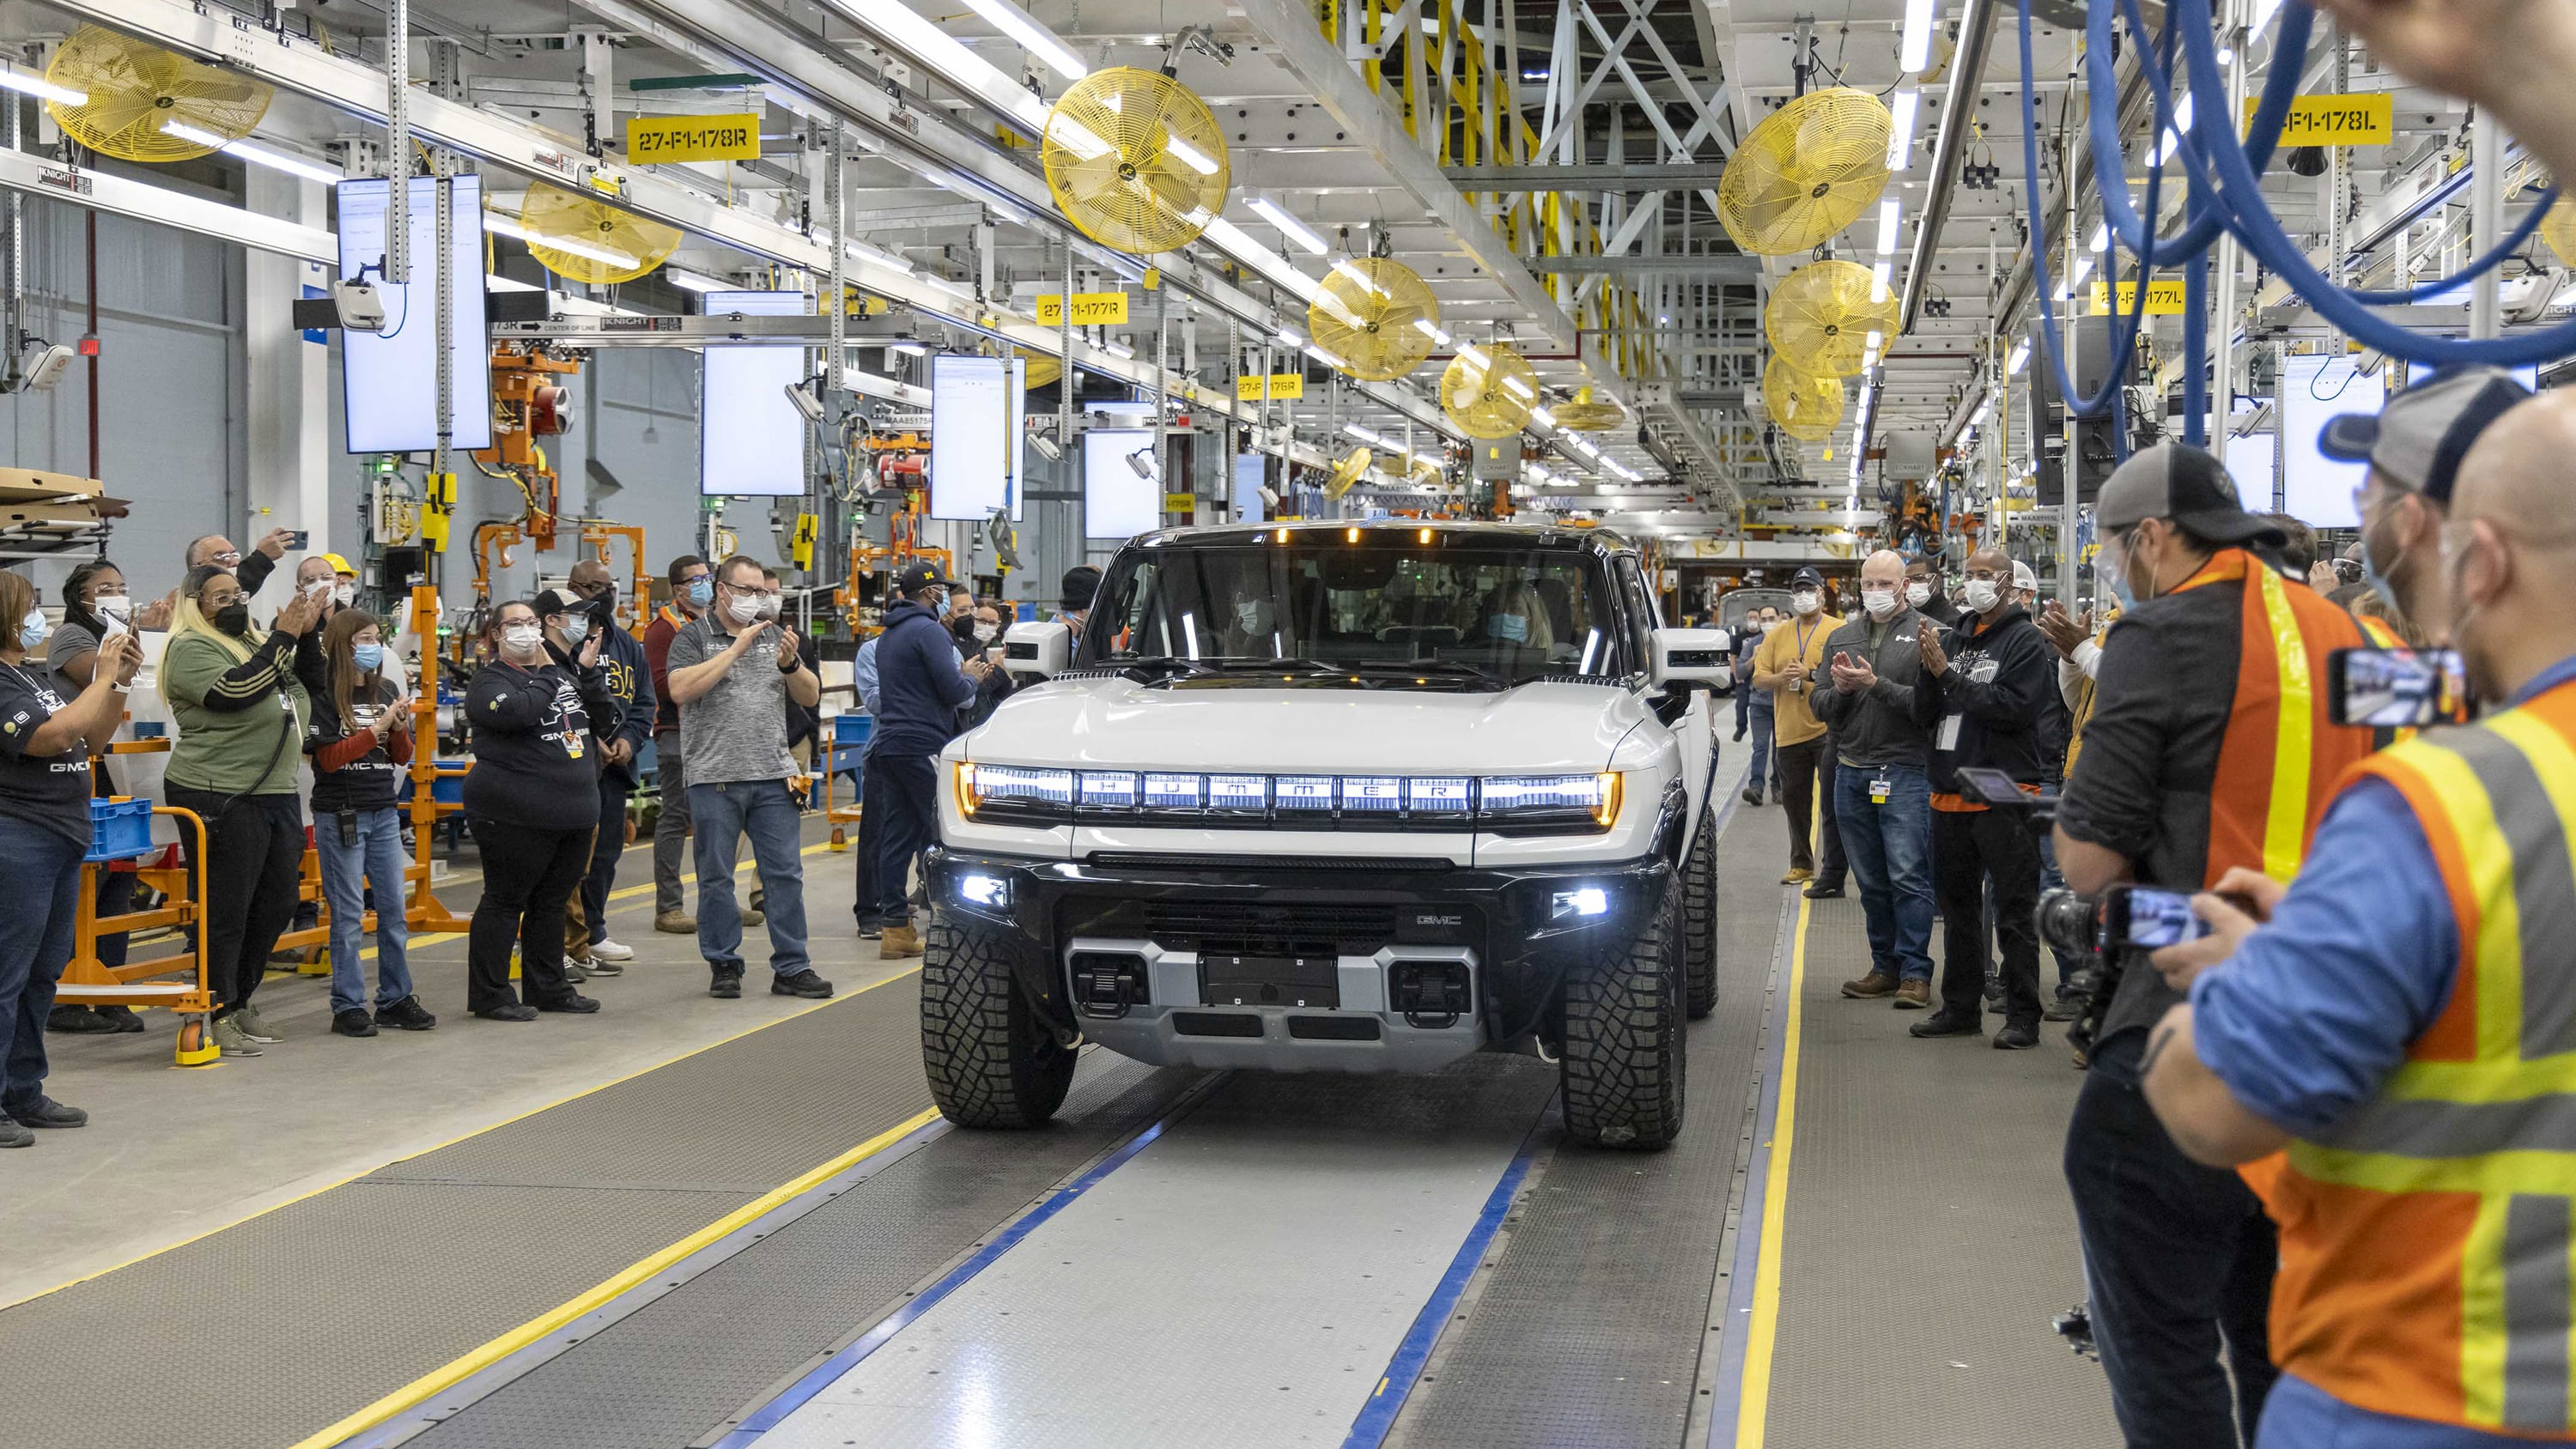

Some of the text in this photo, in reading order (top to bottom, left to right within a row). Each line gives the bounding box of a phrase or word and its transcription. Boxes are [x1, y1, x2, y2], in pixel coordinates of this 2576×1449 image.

[639, 128, 747, 151] 27-F1-178R
[41, 167, 70, 183] KNIGHT
[1044, 302, 1119, 317] 271-177R
[541, 731, 565, 742] GM
[50, 762, 86, 773] GMC
[1100, 782, 1447, 799] HUMMER
[1416, 915, 1461, 925] GMC
